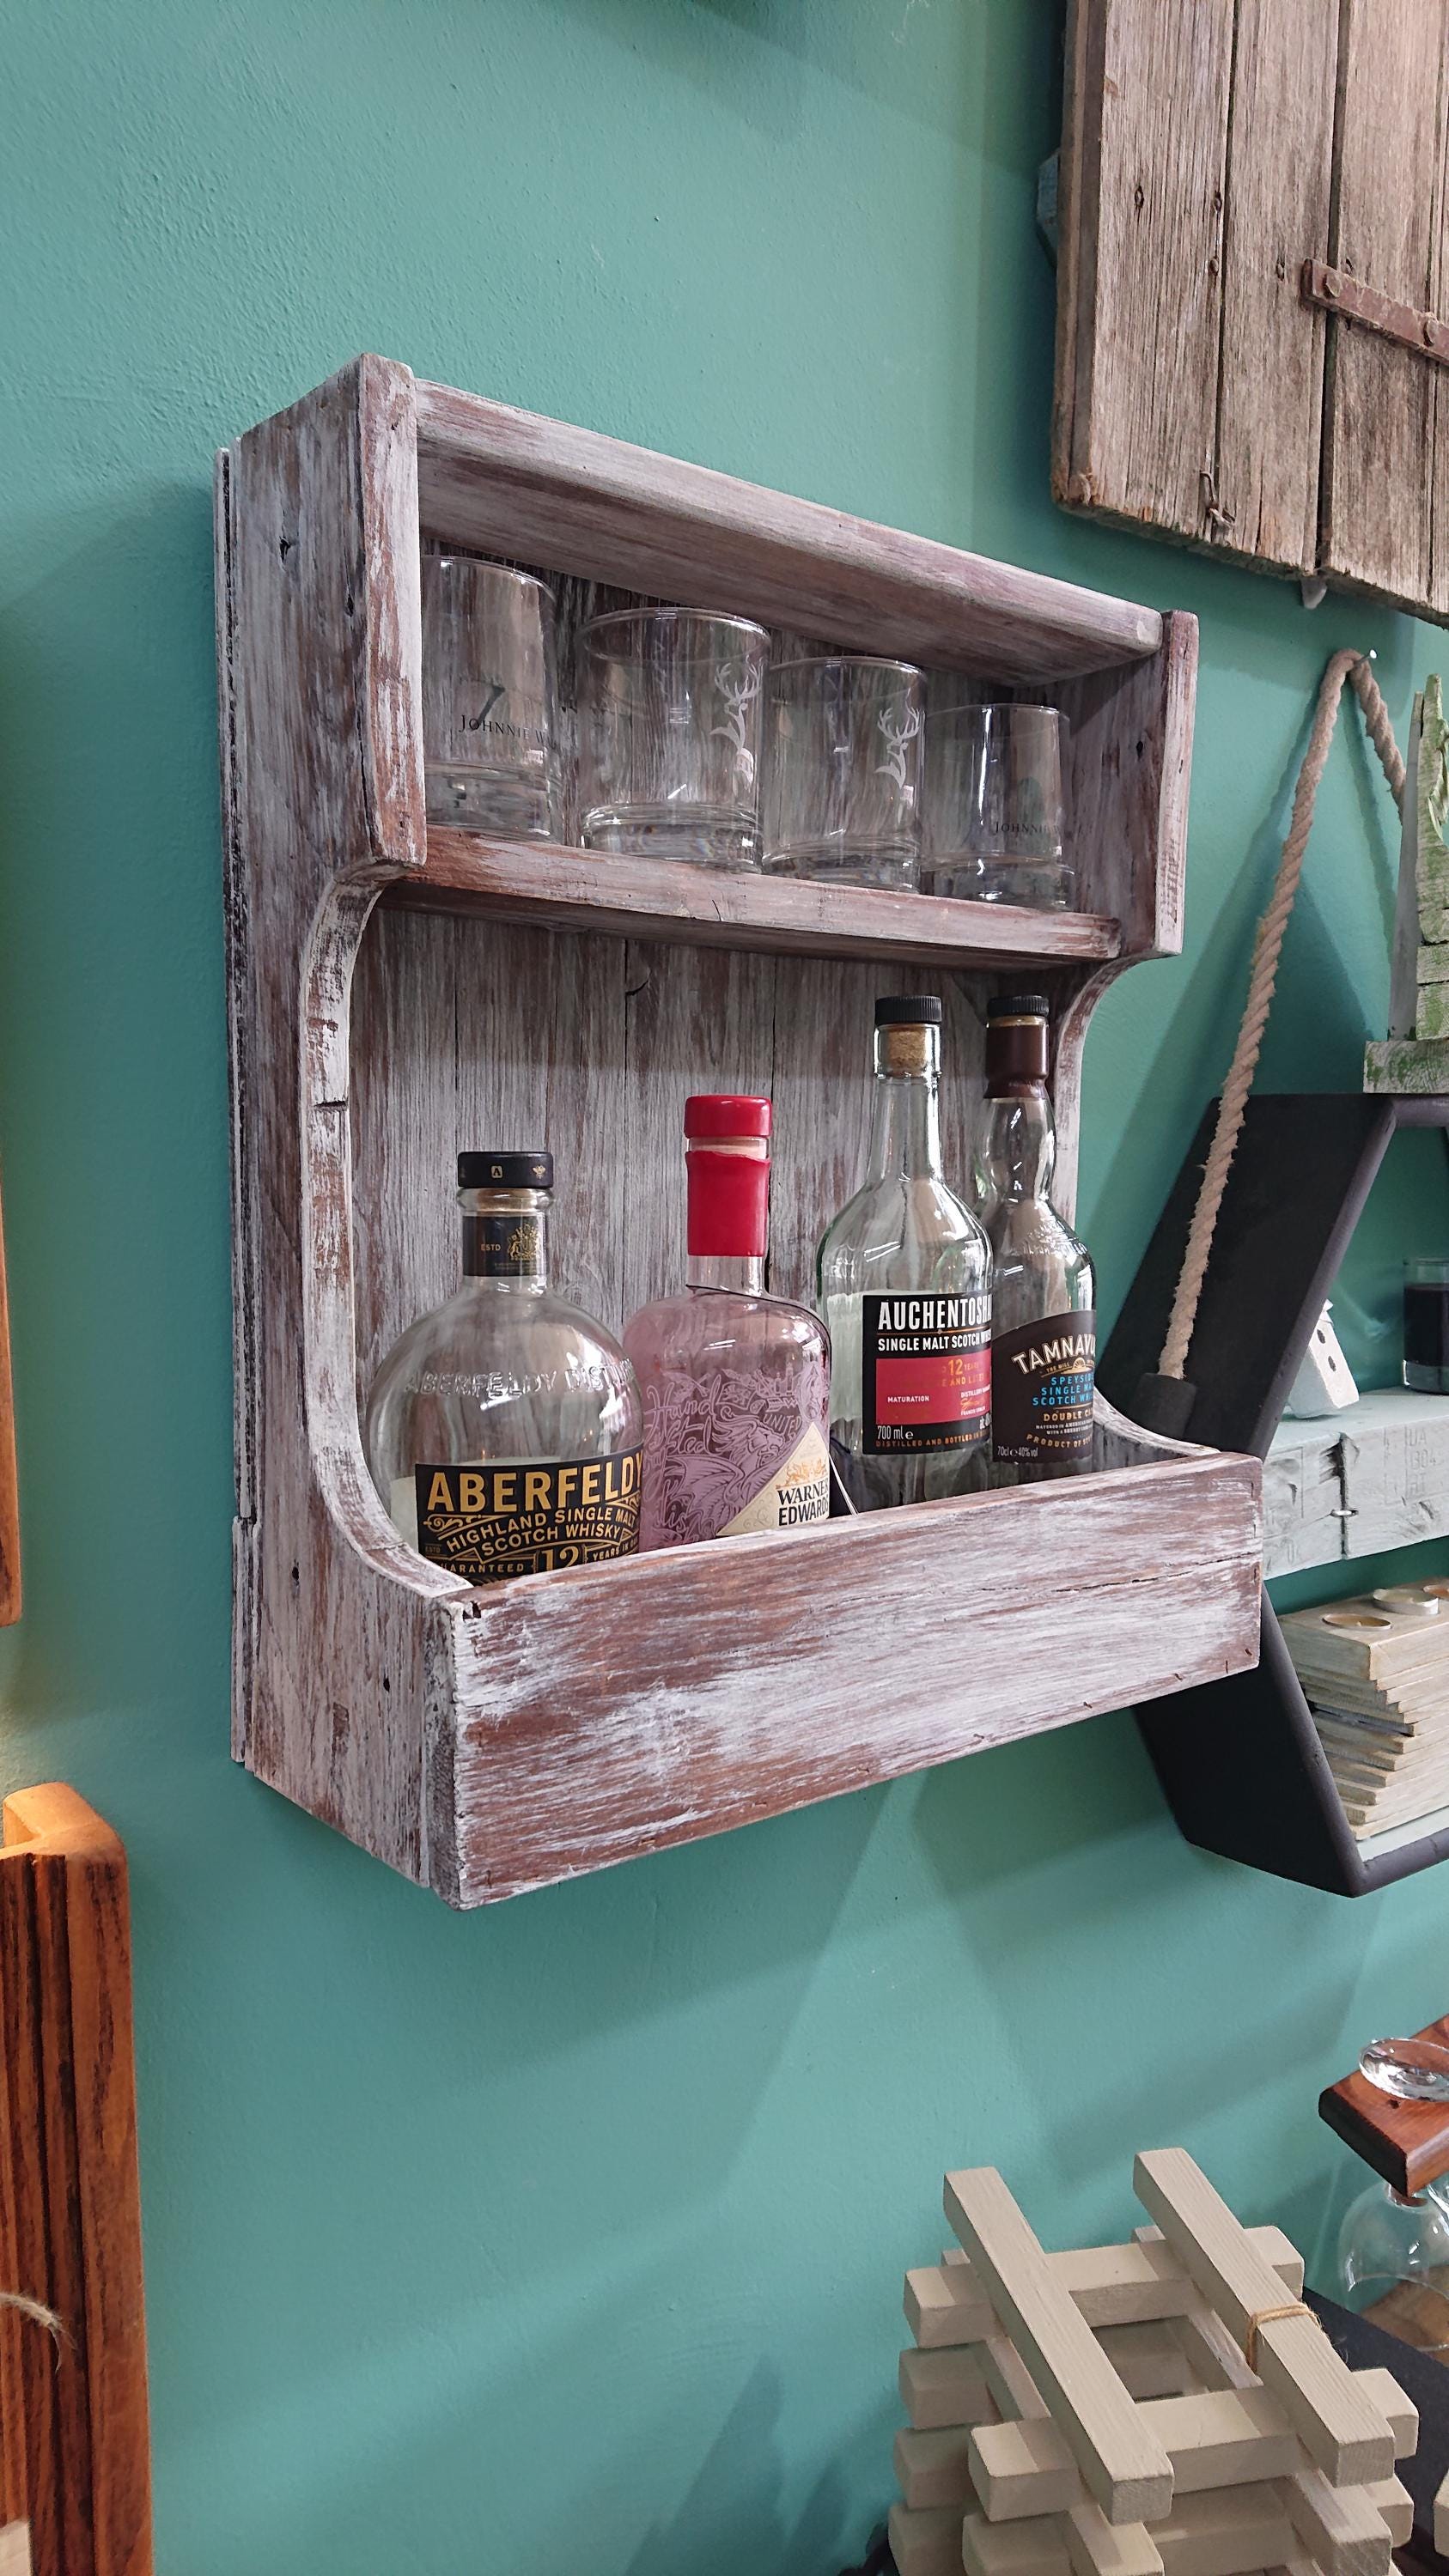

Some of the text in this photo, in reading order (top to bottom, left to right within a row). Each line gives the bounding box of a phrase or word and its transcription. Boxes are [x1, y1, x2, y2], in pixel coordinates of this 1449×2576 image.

[878, 1338, 919, 1351] SINGLE
[922, 1336, 949, 1350] MALT
[951, 1332, 980, 1348] SCOTCH
[1011, 1334, 1096, 1375] TAMNAVU
[948, 1358, 963, 1376] 12
[1041, 1385, 1081, 1395] SINGLE
[1032, 1395, 1076, 1406] SCOTCH
[1043, 1412, 1082, 1421] DOUBLE
[877, 1425, 892, 1440] 700
[893, 1426, 904, 1440] ml
[945, 1434, 972, 1444] BOTTLED
[1026, 1434, 1070, 1448] PRODUCT
[427, 1449, 643, 1513] ABERFELDY
[777, 1478, 829, 1506] WARNER
[778, 1496, 829, 1526] EDWARDS
[447, 1507, 636, 1552] HIGHLAND SINGLE MALT
[481, 1523, 620, 1556] SCOTCH WHISKY
[593, 1547, 619, 1561] YEARS
